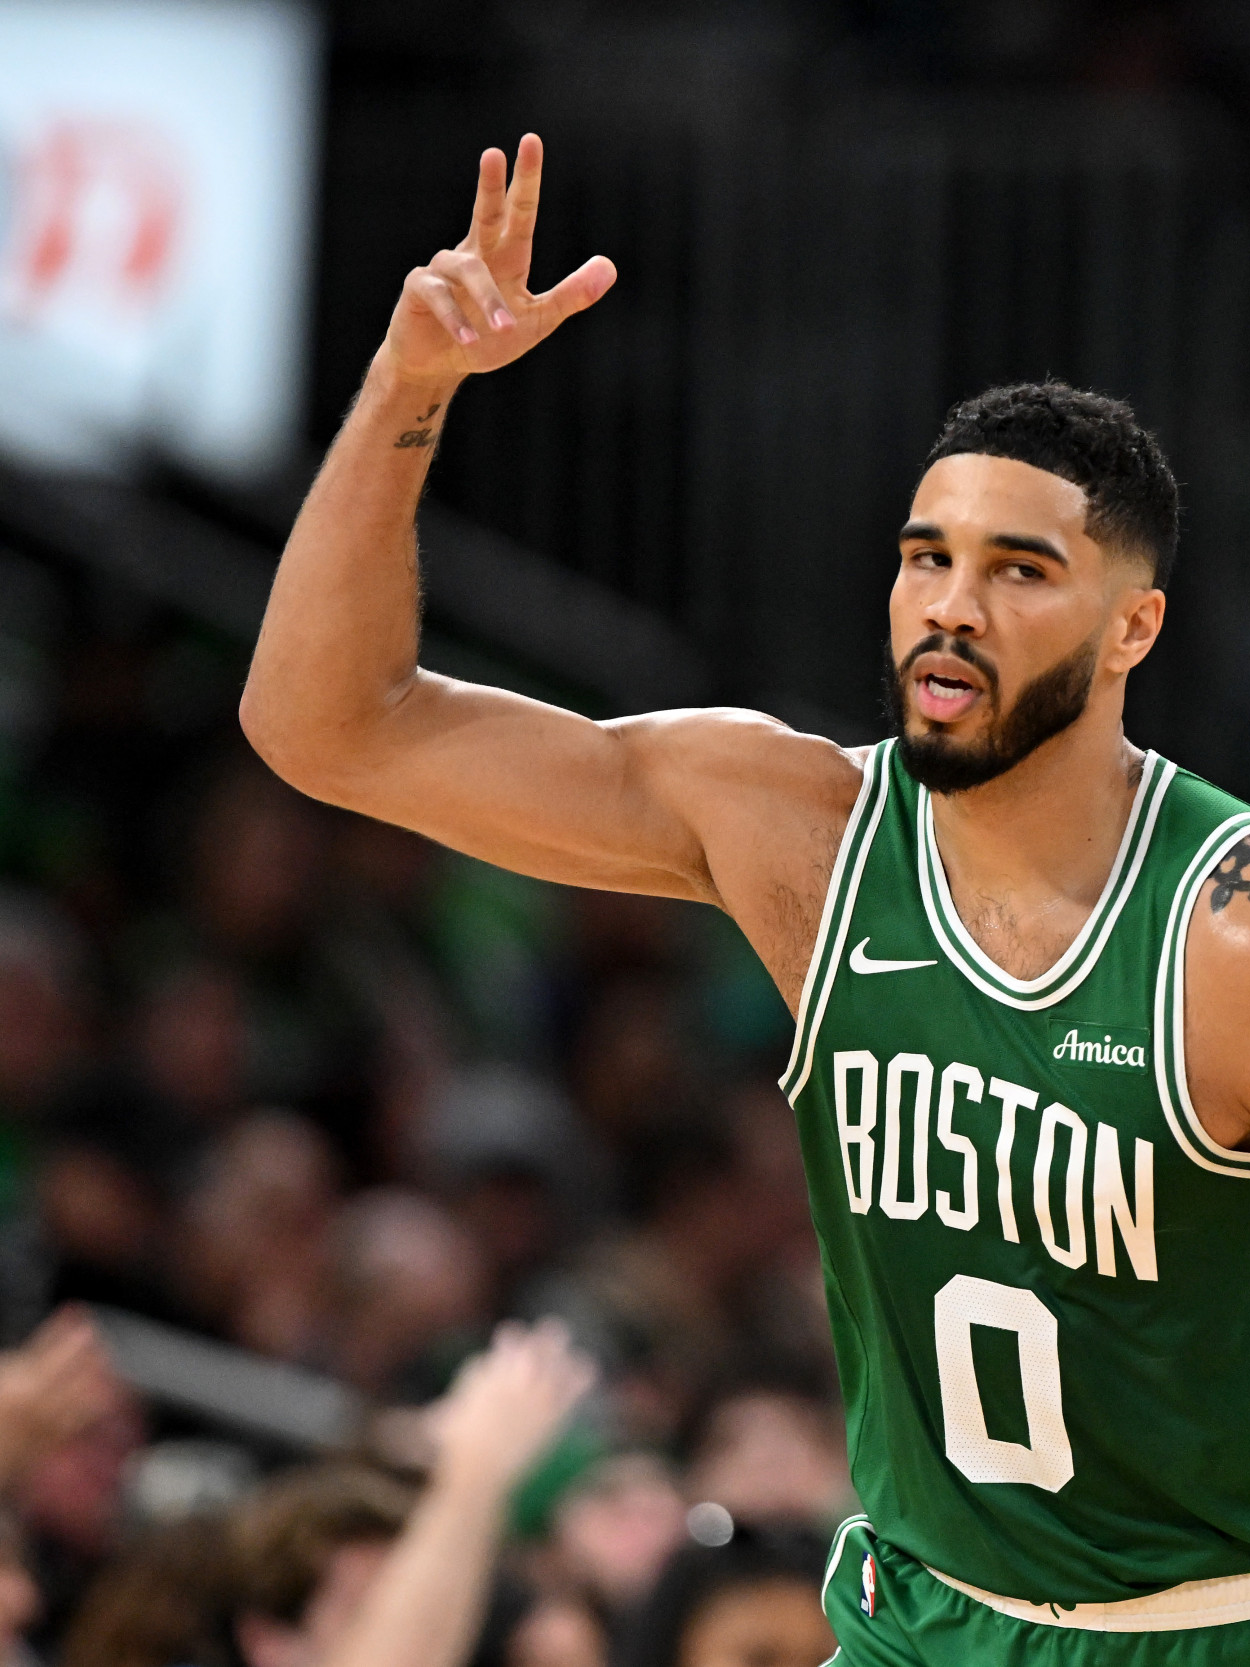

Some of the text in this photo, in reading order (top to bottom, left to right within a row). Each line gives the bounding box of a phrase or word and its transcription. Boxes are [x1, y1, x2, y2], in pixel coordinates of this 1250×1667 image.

[1053, 1029, 1146, 1067] Amica
[834, 1050, 1158, 1281] BOSTON
[934, 1274, 1075, 1493] 0
